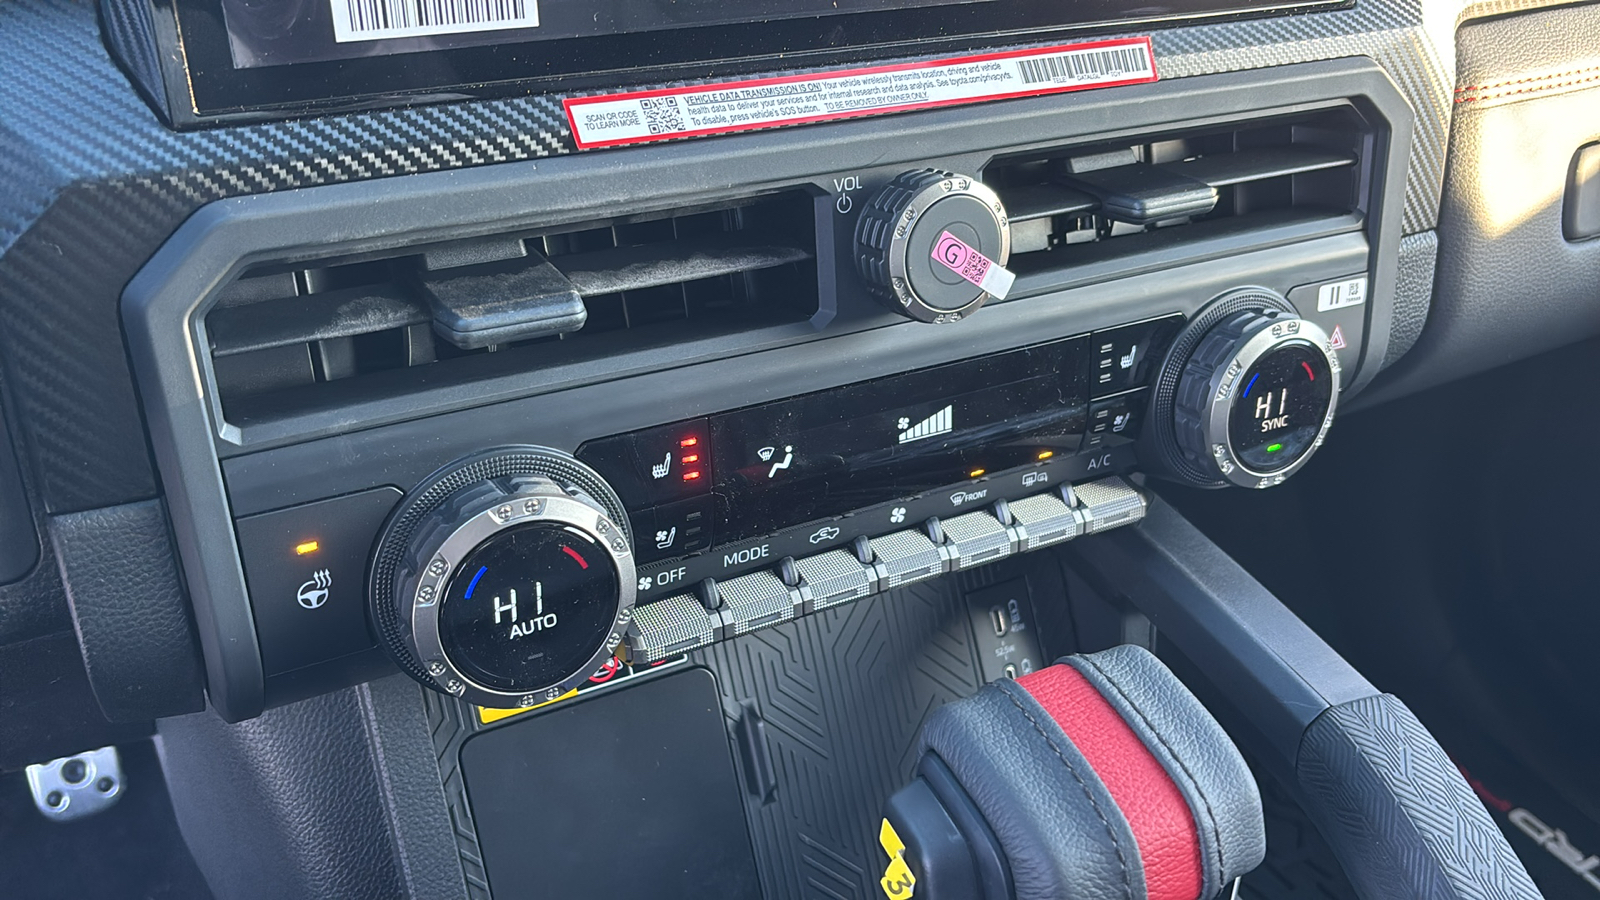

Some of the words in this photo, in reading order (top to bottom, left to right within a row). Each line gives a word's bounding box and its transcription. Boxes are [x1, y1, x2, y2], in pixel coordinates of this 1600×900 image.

[683, 93, 718, 104] VEHICLE
[718, 90, 740, 101] DATA
[740, 84, 798, 99] TRANSMISSION
[798, 84, 807, 92] IS
[822, 81, 837, 91] Your
[838, 78, 861, 89] vehicle
[862, 74, 892, 86] wirelessly
[892, 71, 920, 82] transmits
[921, 68, 947, 80] location,
[947, 66, 968, 76] driving
[968, 64, 980, 73] and
[980, 62, 1001, 72] vehicle
[687, 104, 710, 116] health
[710, 103, 727, 113] data
[728, 102, 736, 111] to
[736, 99, 760, 110] deliver
[760, 99, 776, 110] your
[777, 94, 804, 106] services
[804, 93, 818, 102] and
[818, 91, 828, 101] for
[828, 89, 852, 99] internal
[853, 86, 881, 97] research
[881, 84, 894, 93] and
[894, 82, 909, 91] data
[909, 80, 936, 90] analysis.
[936, 79, 949, 87] See
[586, 114, 606, 122] SCAN
[618, 110, 638, 119] CODE
[691, 117, 701, 126] To
[702, 113, 730, 125] disable,
[730, 112, 750, 125] press
[750, 107, 780, 119] vehicle's
[780, 105, 796, 116] SOS
[796, 104, 820, 114] button.
[824, 102, 834, 110] TO
[845, 97, 877, 107] REMOVED
[887, 93, 911, 102] OWNER
[584, 122, 596, 131] TO
[596, 120, 620, 130] LEARN
[620, 118, 641, 127] MORE
[834, 176, 862, 192] VOL
[944, 243, 962, 264] G
[1255, 388, 1287, 418] HI
[1261, 414, 1289, 432] SYNC
[1087, 454, 1112, 471] A/C
[964, 489, 988, 502] FRONT
[723, 544, 770, 568] MODE
[656, 566, 687, 586] OFF
[493, 581, 543, 624] HI
[509, 613, 558, 640] AUTO
